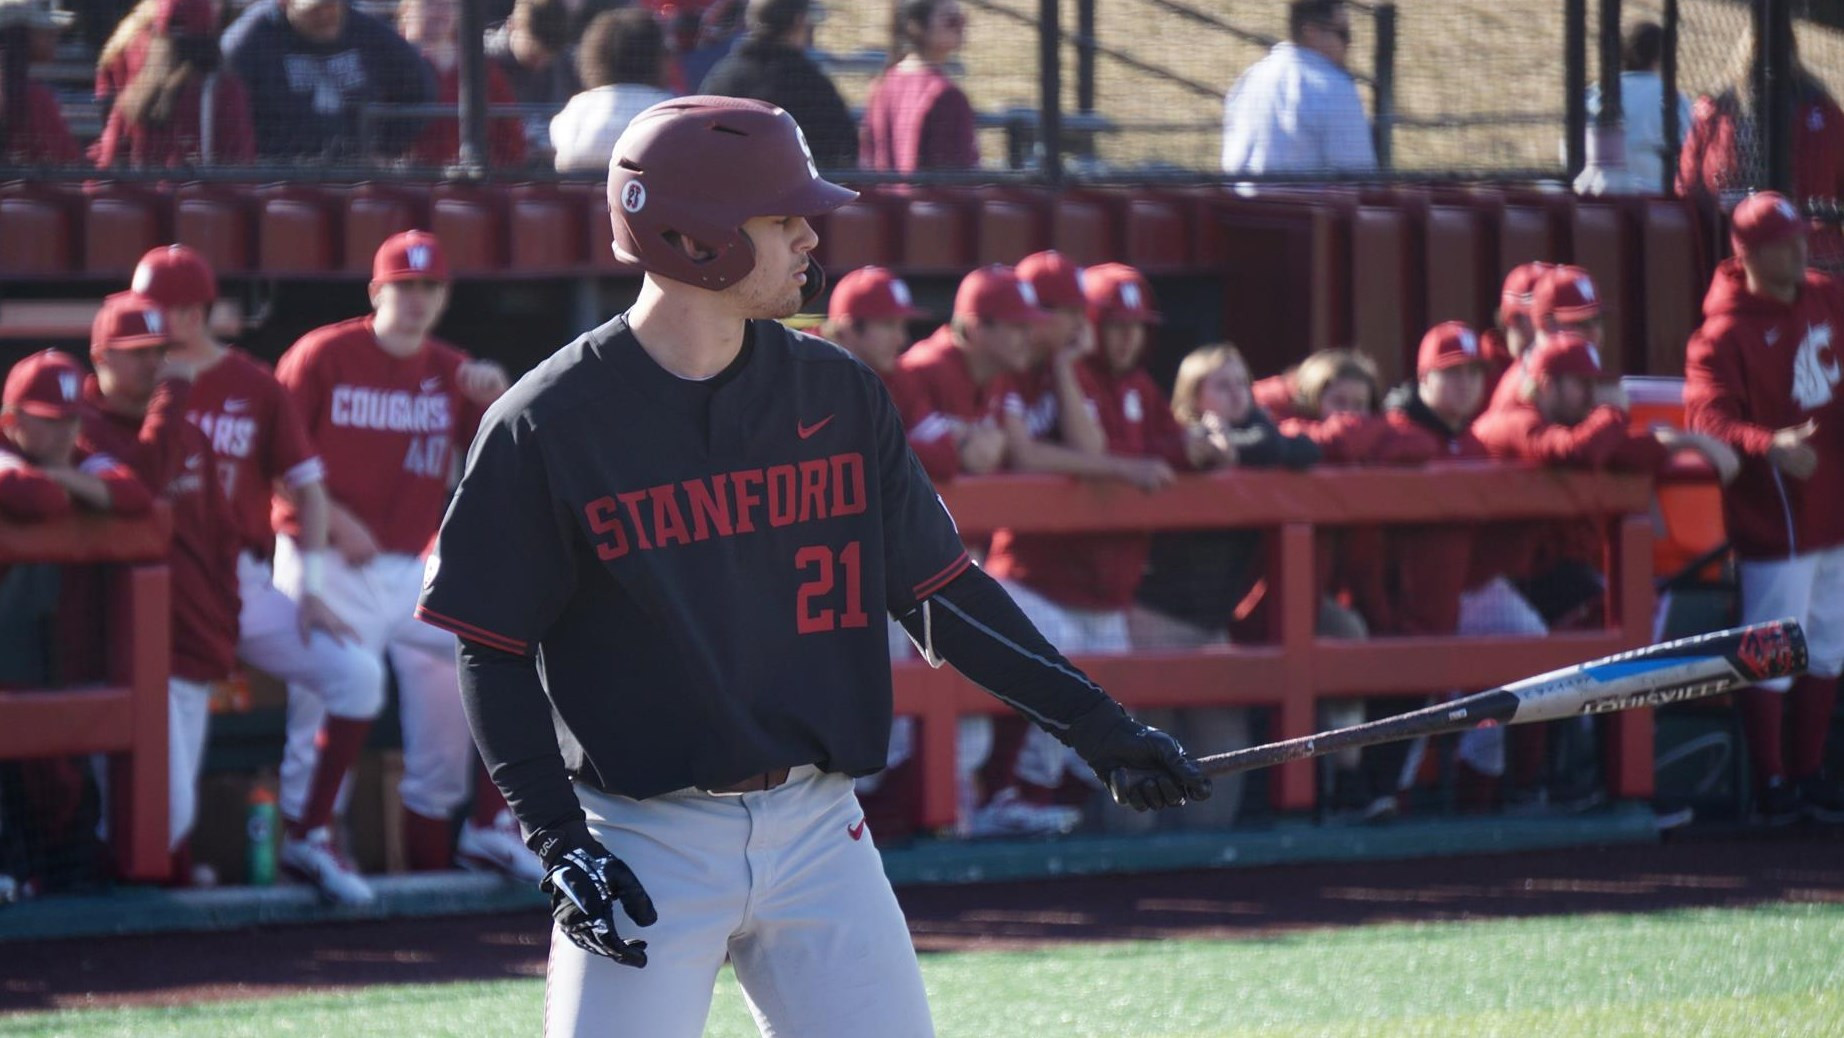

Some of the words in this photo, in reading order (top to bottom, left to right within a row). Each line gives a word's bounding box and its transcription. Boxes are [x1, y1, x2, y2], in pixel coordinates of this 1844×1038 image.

[331, 384, 450, 432] COUGARS
[584, 452, 867, 561] STANFORD
[795, 541, 868, 634] 21
